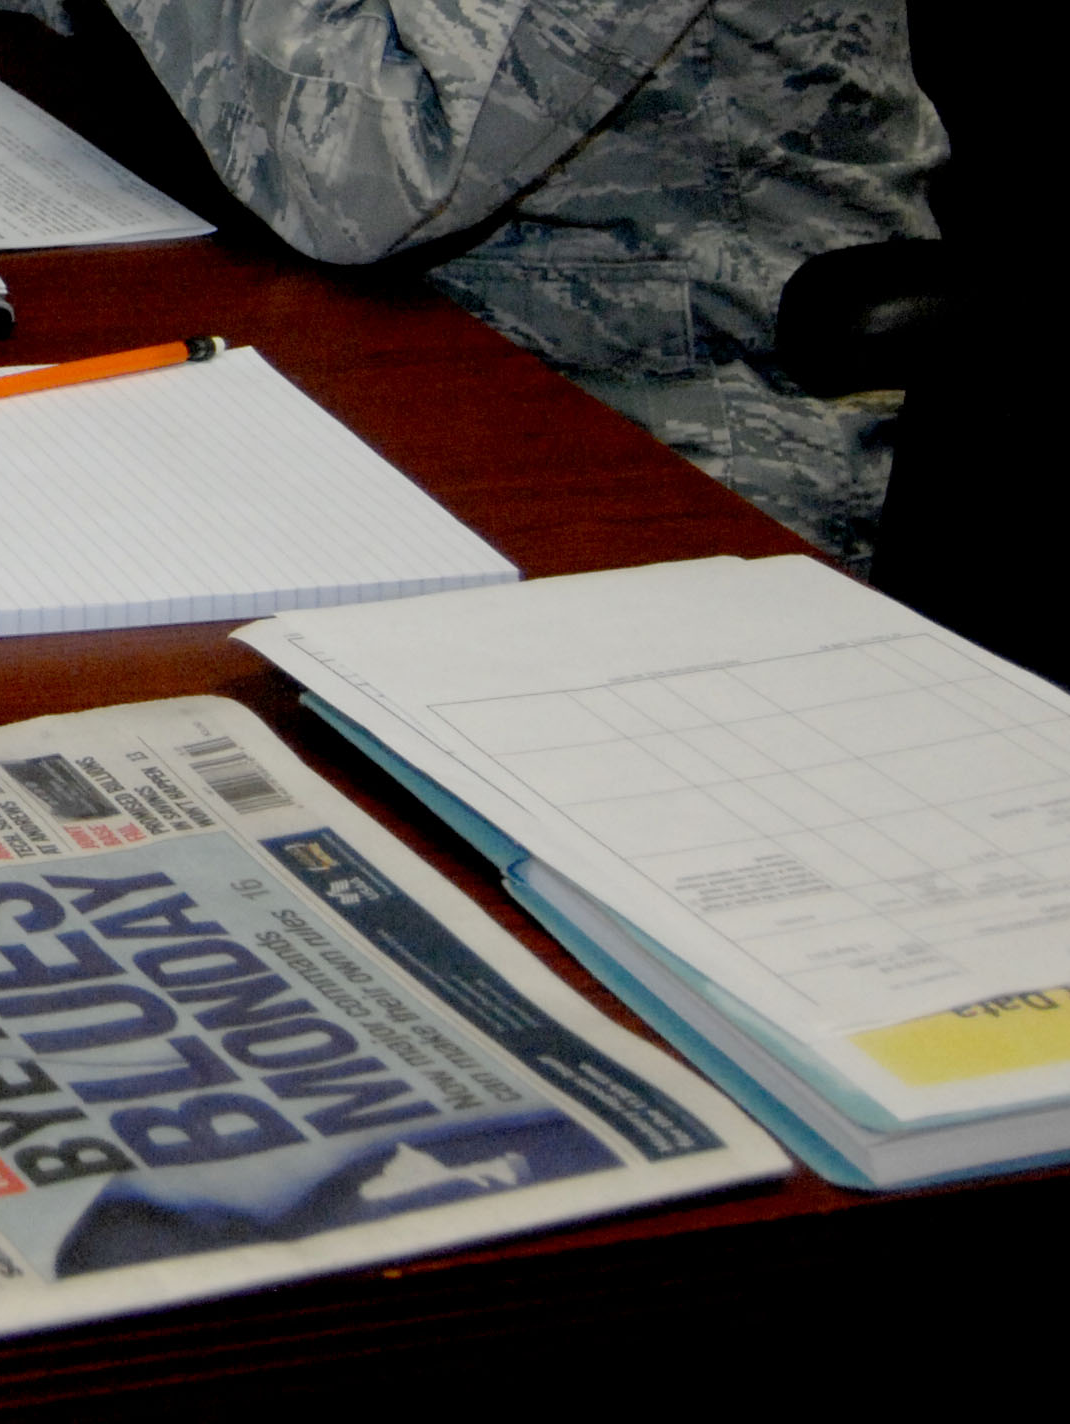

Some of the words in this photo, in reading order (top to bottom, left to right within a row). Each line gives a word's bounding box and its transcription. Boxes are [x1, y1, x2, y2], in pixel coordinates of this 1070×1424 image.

[70, 755, 129, 793] BILLIONS
[136, 765, 191, 800] HAPPEN
[108, 791, 174, 836] PROMISED
[129, 784, 184, 820] SAVINGS
[172, 799, 220, 828] WON'T
[166, 819, 195, 831] IN
[34, 843, 63, 855] AT
[225, 877, 277, 901] 16
[265, 908, 335, 948] rules
[247, 930, 377, 1019] commands
[315, 948, 377, 984] own
[40, 870, 441, 1138] MONDAY
[352, 985, 424, 1024] their
[354, 1019, 435, 1066] major
[401, 1022, 485, 1071] make
[417, 1069, 487, 1111] Now
[464, 1070, 526, 1104] can
